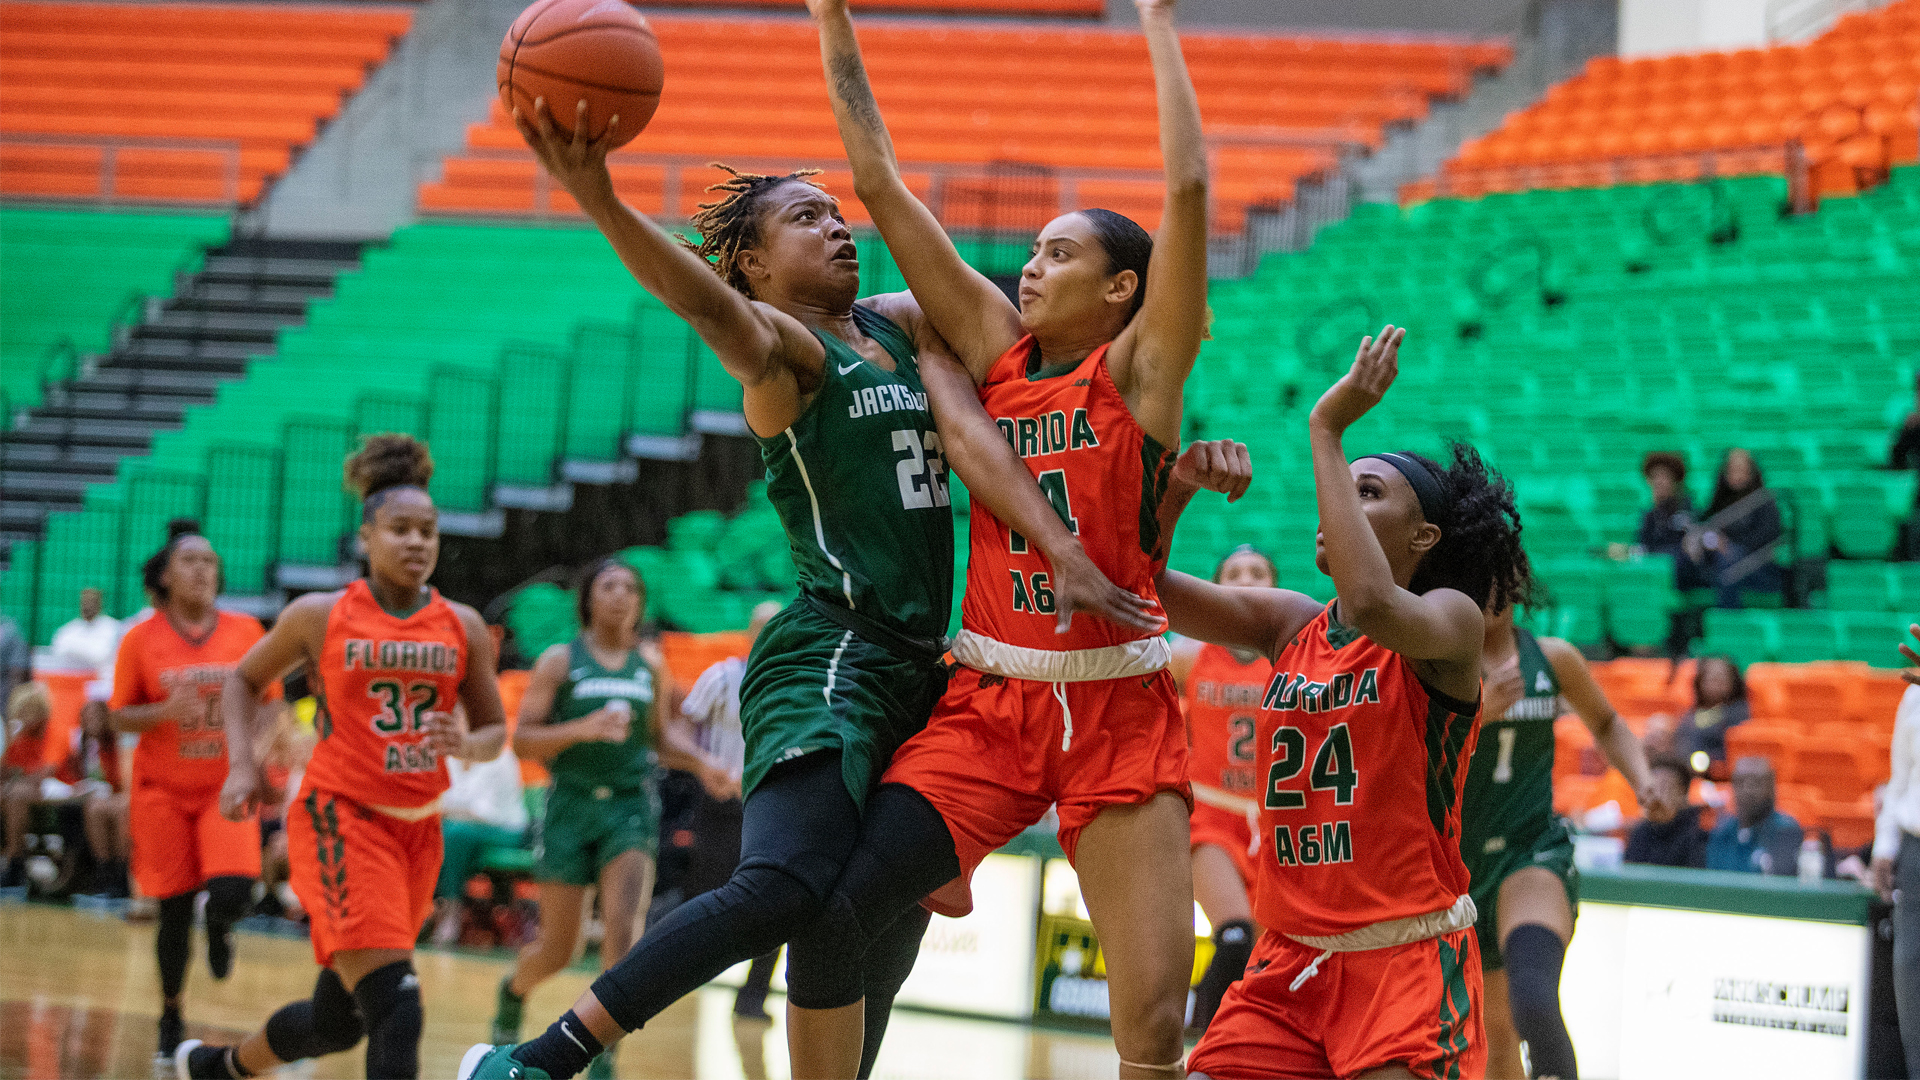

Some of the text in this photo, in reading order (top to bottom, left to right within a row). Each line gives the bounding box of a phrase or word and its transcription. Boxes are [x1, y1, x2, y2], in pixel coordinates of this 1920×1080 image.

[891, 429, 951, 511] 22
[1008, 468, 1080, 555] 4
[367, 677, 442, 737] 32
[1265, 722, 1358, 811] 24
[1492, 727, 1517, 784] 1
[1275, 820, 1353, 867] A&M
